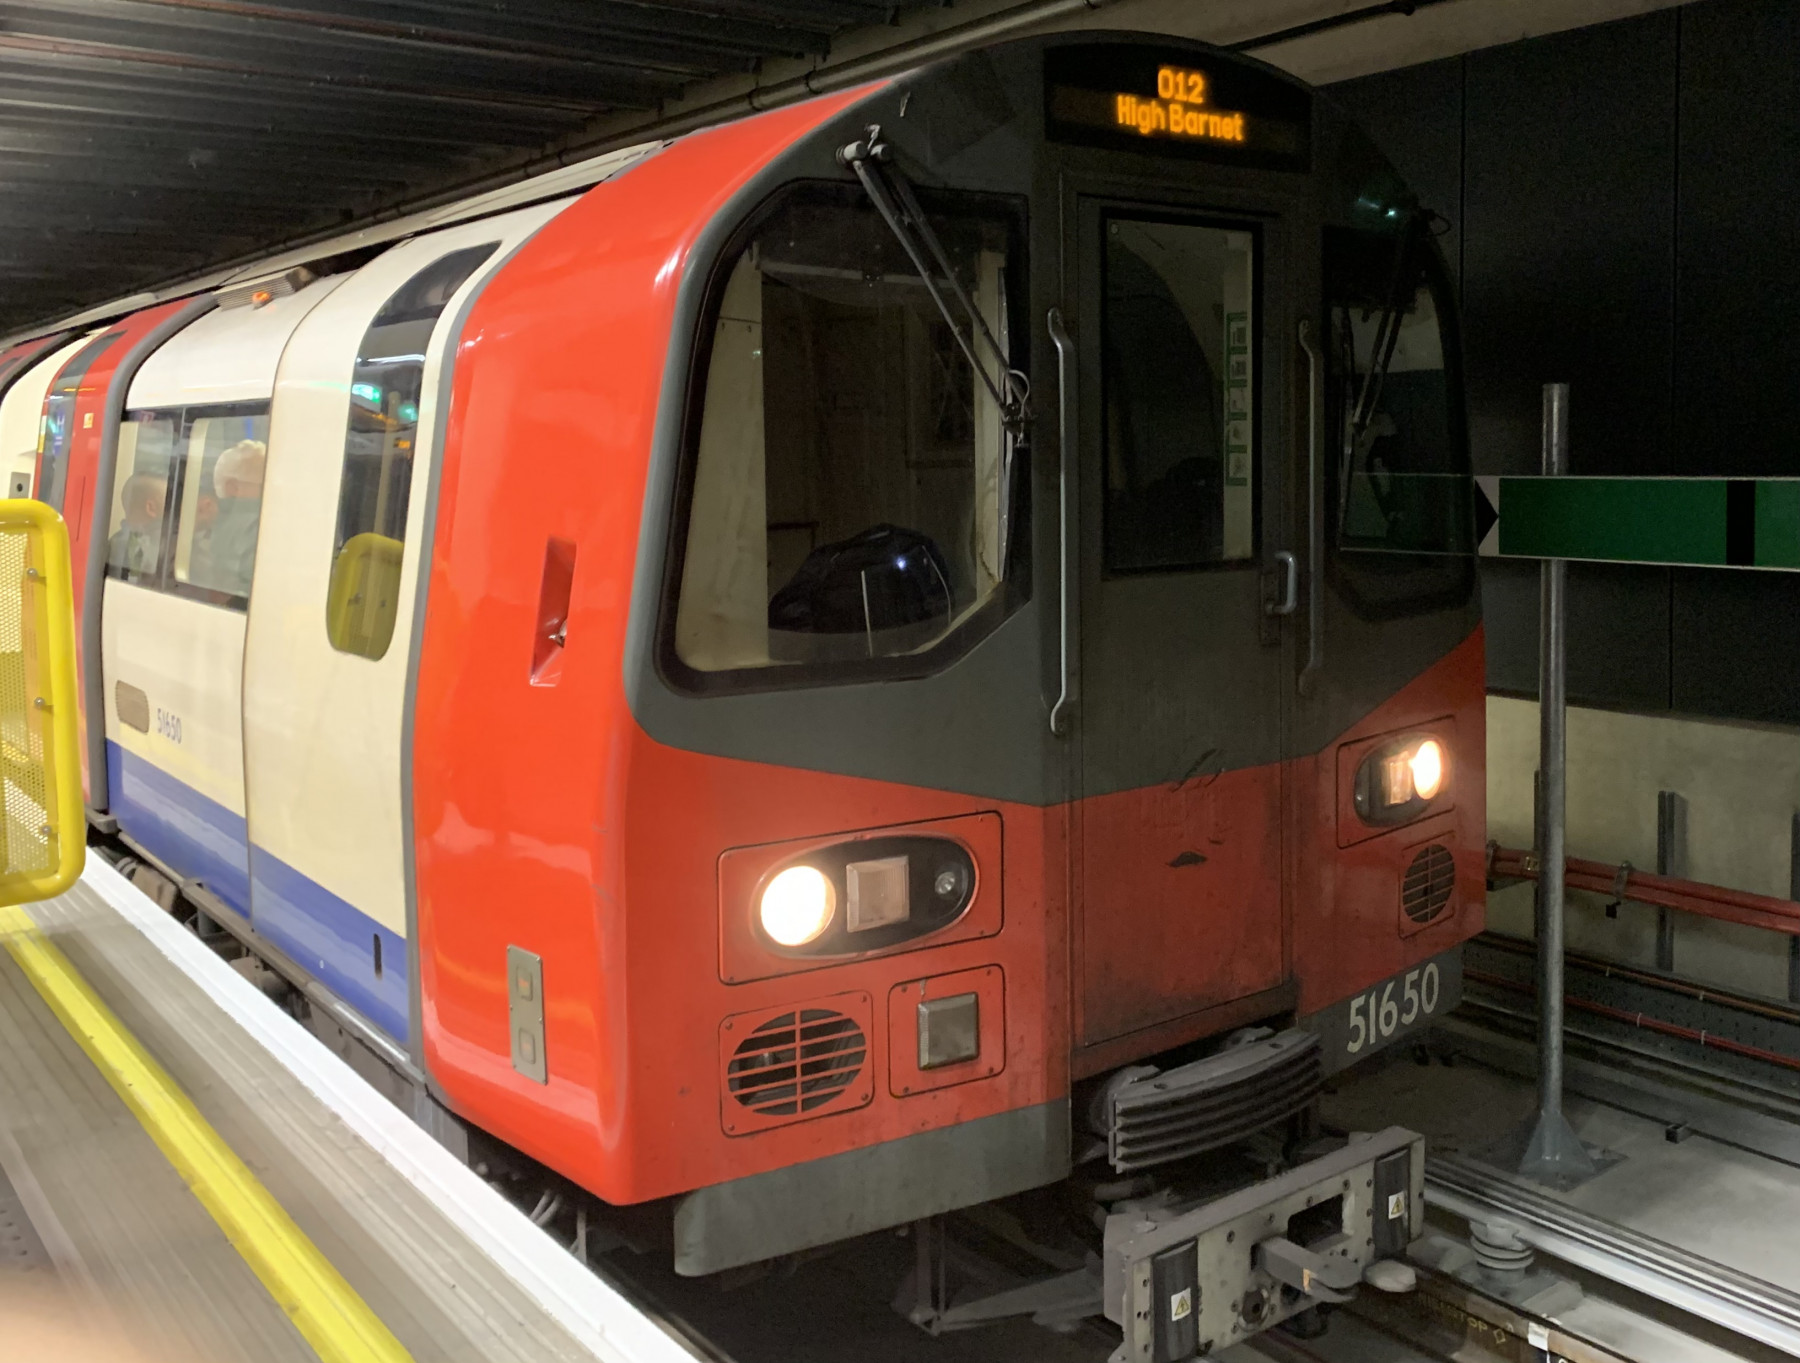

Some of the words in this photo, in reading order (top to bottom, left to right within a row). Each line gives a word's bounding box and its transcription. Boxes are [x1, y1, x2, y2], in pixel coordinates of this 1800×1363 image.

[1157, 68, 1204, 104] 012
[1117, 94, 1165, 135] High
[1169, 103, 1244, 141] Barnet
[157, 707, 182, 744] 51650
[1346, 962, 1440, 1054] 51650
